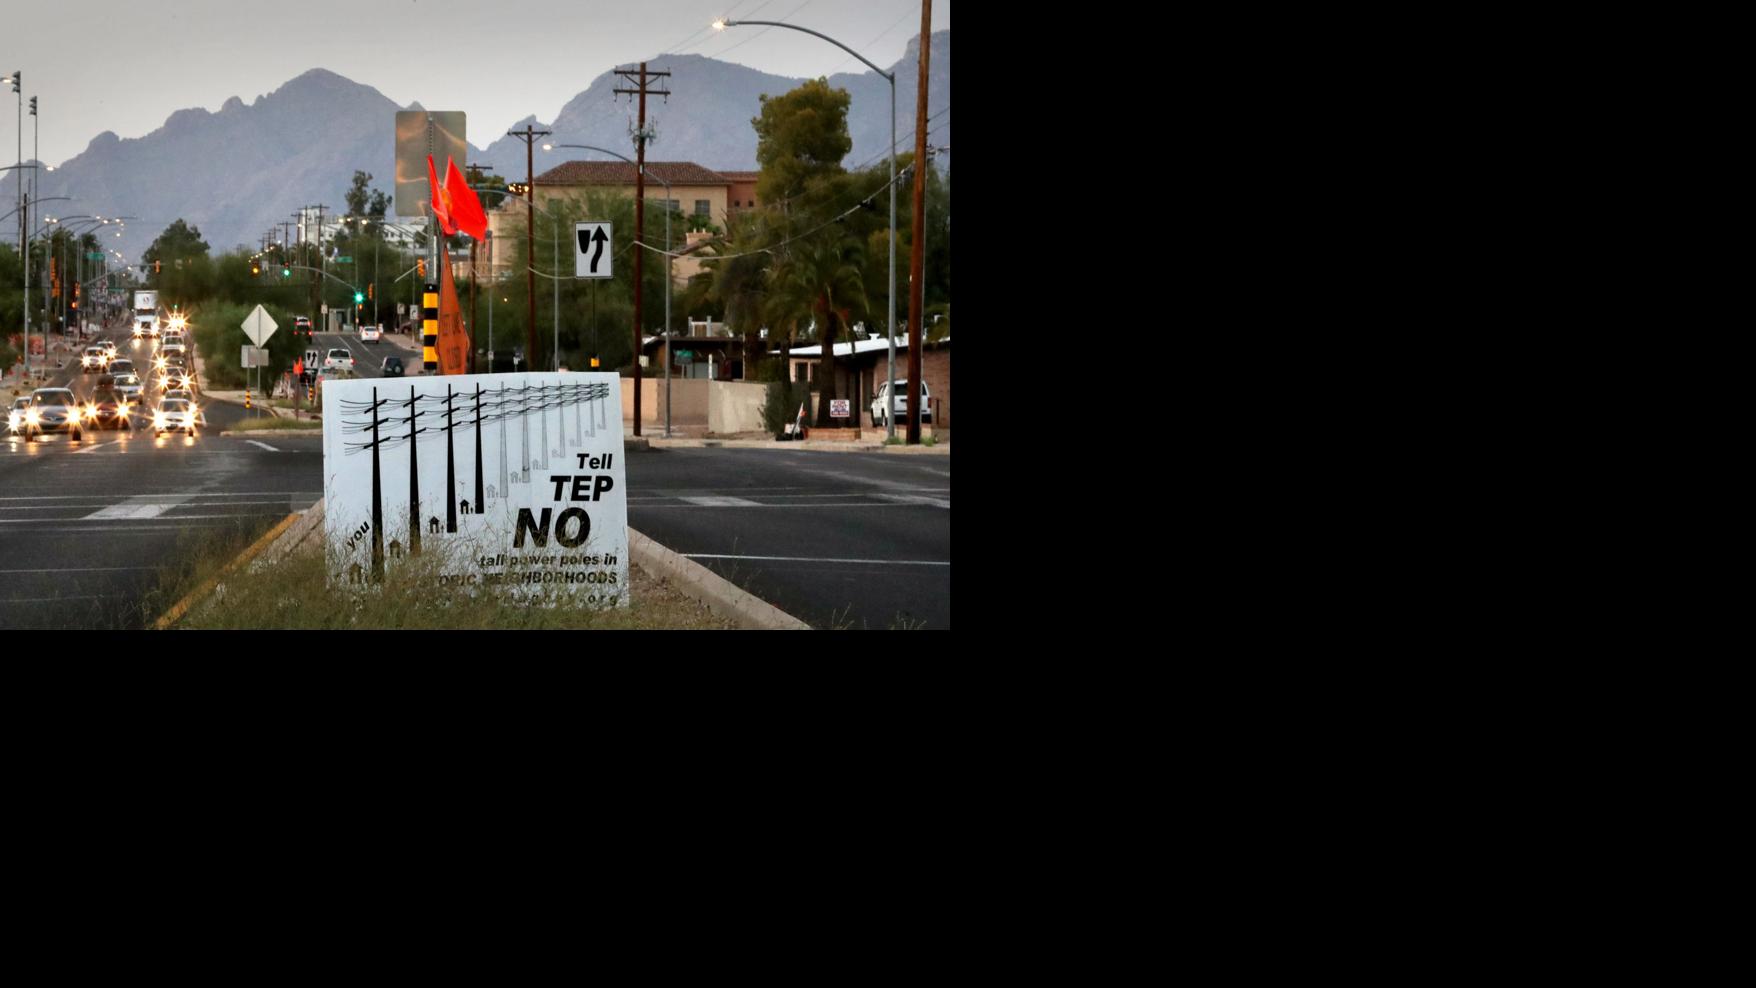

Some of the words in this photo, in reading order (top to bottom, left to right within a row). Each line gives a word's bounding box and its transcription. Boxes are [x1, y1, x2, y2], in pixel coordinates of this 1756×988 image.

[576, 453, 613, 470] Tell
[550, 475, 614, 502] TEP
[346, 521, 370, 552] you
[513, 507, 591, 549] NO
[480, 554, 505, 567] tall
[510, 555, 555, 568] power
[559, 555, 600, 568] poles
[603, 553, 618, 566] in
[483, 571, 618, 586] EGHBORHOODS
